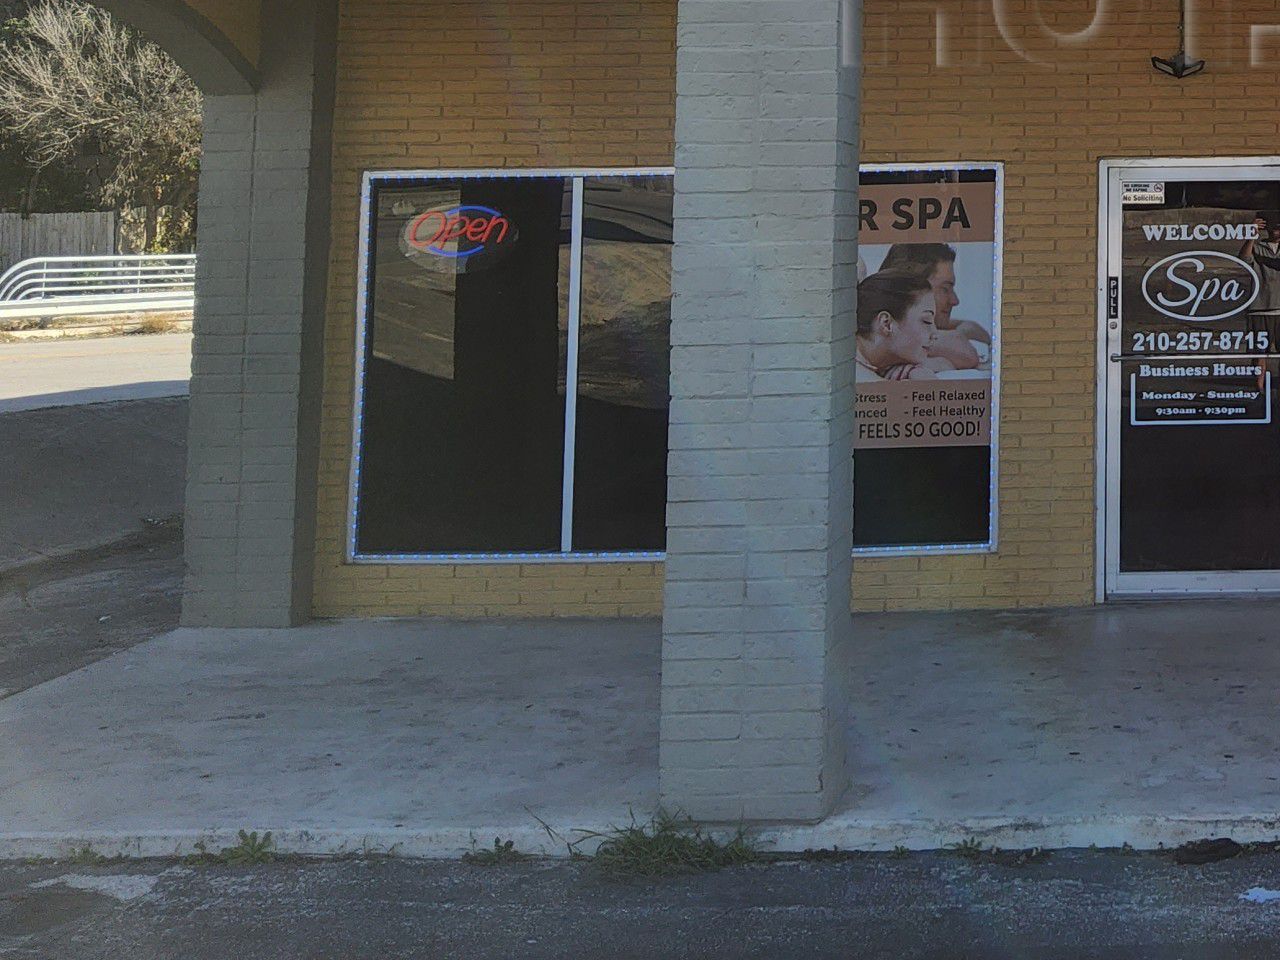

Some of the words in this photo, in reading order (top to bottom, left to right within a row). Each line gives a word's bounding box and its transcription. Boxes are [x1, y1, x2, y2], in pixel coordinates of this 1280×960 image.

[891, 197, 971, 230] SPA
[409, 210, 509, 250] Open
[1142, 224, 1259, 240] WELCOME
[1156, 257, 1245, 316] Spa
[1132, 331, 1270, 352] 210-257-8715
[1139, 364, 1210, 377] Business
[1212, 363, 1262, 376] Hours
[912, 391, 935, 401] Feel
[939, 389, 986, 401] Relaxed
[1142, 391, 1197, 400] Monday
[1206, 390, 1260, 399] Sunday
[912, 406, 937, 417] Feel
[939, 405, 986, 418] Healthy
[1155, 407, 1197, 415] 9:30am
[1204, 406, 1246, 415] 9:30pm
[859, 423, 900, 439] FEELS
[904, 422, 924, 437] SO
[929, 420, 981, 437] GOOD!
